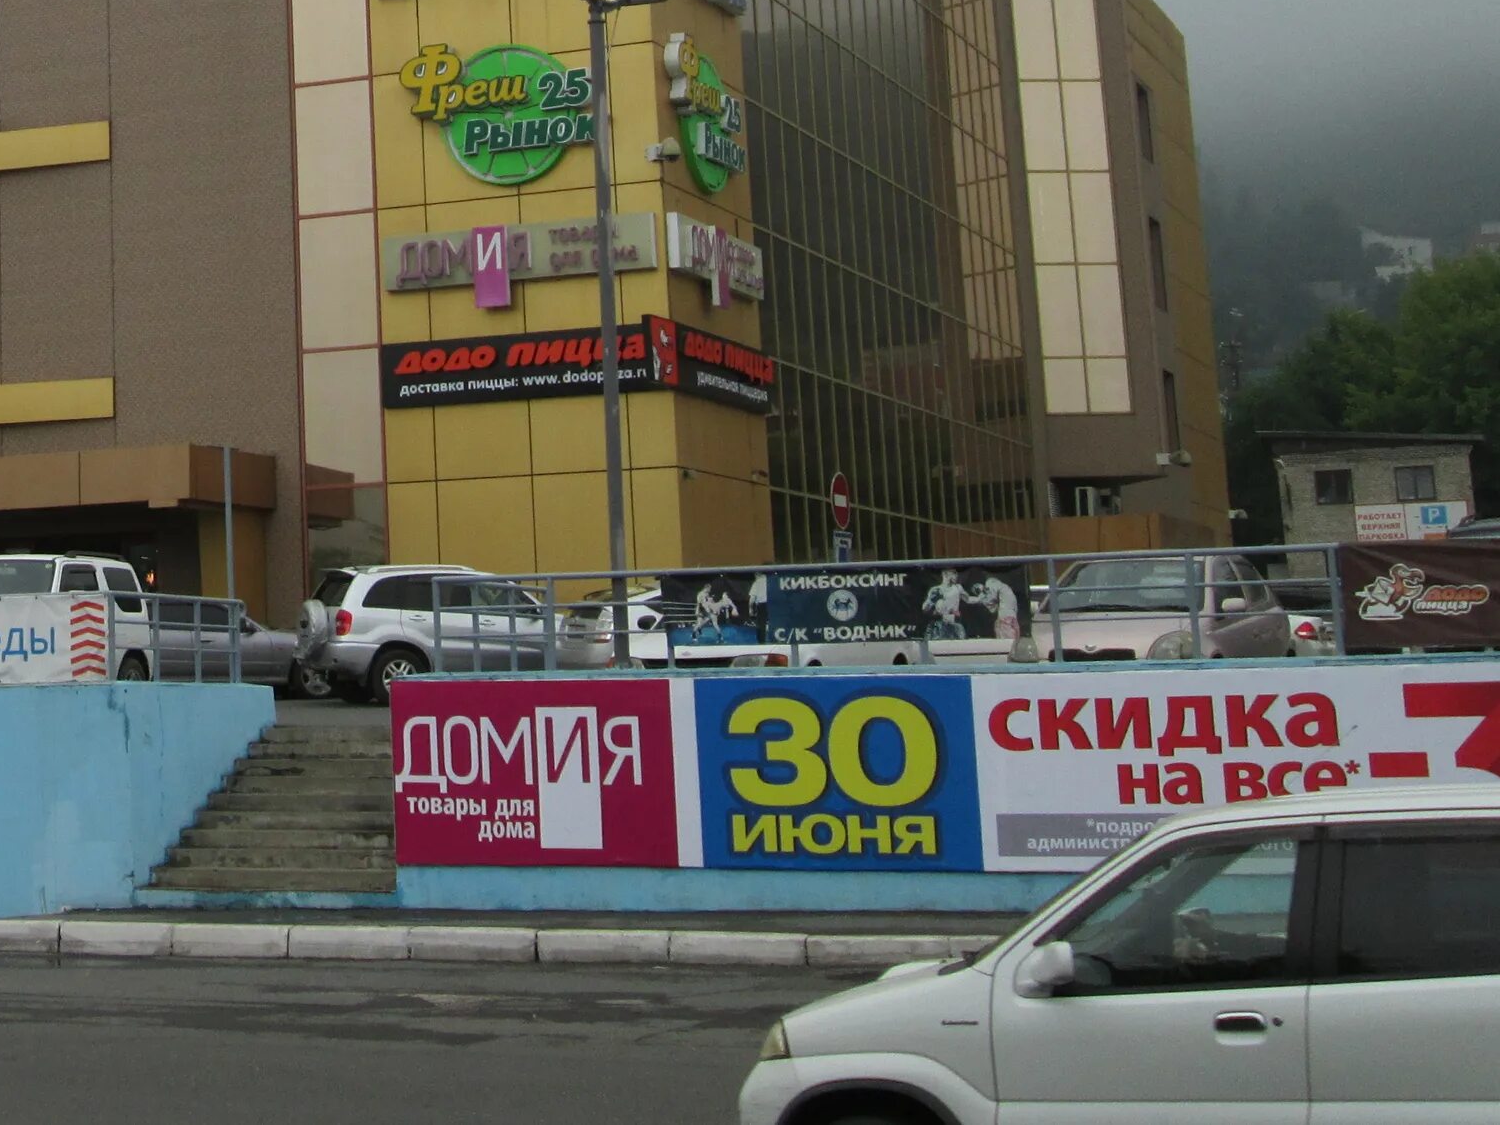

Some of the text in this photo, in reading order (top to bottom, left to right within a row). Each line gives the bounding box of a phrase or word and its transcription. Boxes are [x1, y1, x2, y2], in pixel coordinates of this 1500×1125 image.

[400, 43, 526, 121] Фреш
[537, 67, 591, 111] 25
[400, 380, 464, 398] доставка
[1357, 512, 1402, 521] РАБОТАЕТ
[779, 572, 908, 591] КИКБОКСИНГ
[773, 627, 809, 644] С/К
[395, 715, 643, 793] ДОМИЯ
[728, 695, 938, 807] 30
[1117, 762, 1205, 805] на
[406, 796, 535, 821] товары для
[478, 820, 536, 842] дома
[731, 813, 938, 855] ИЮНЯ
